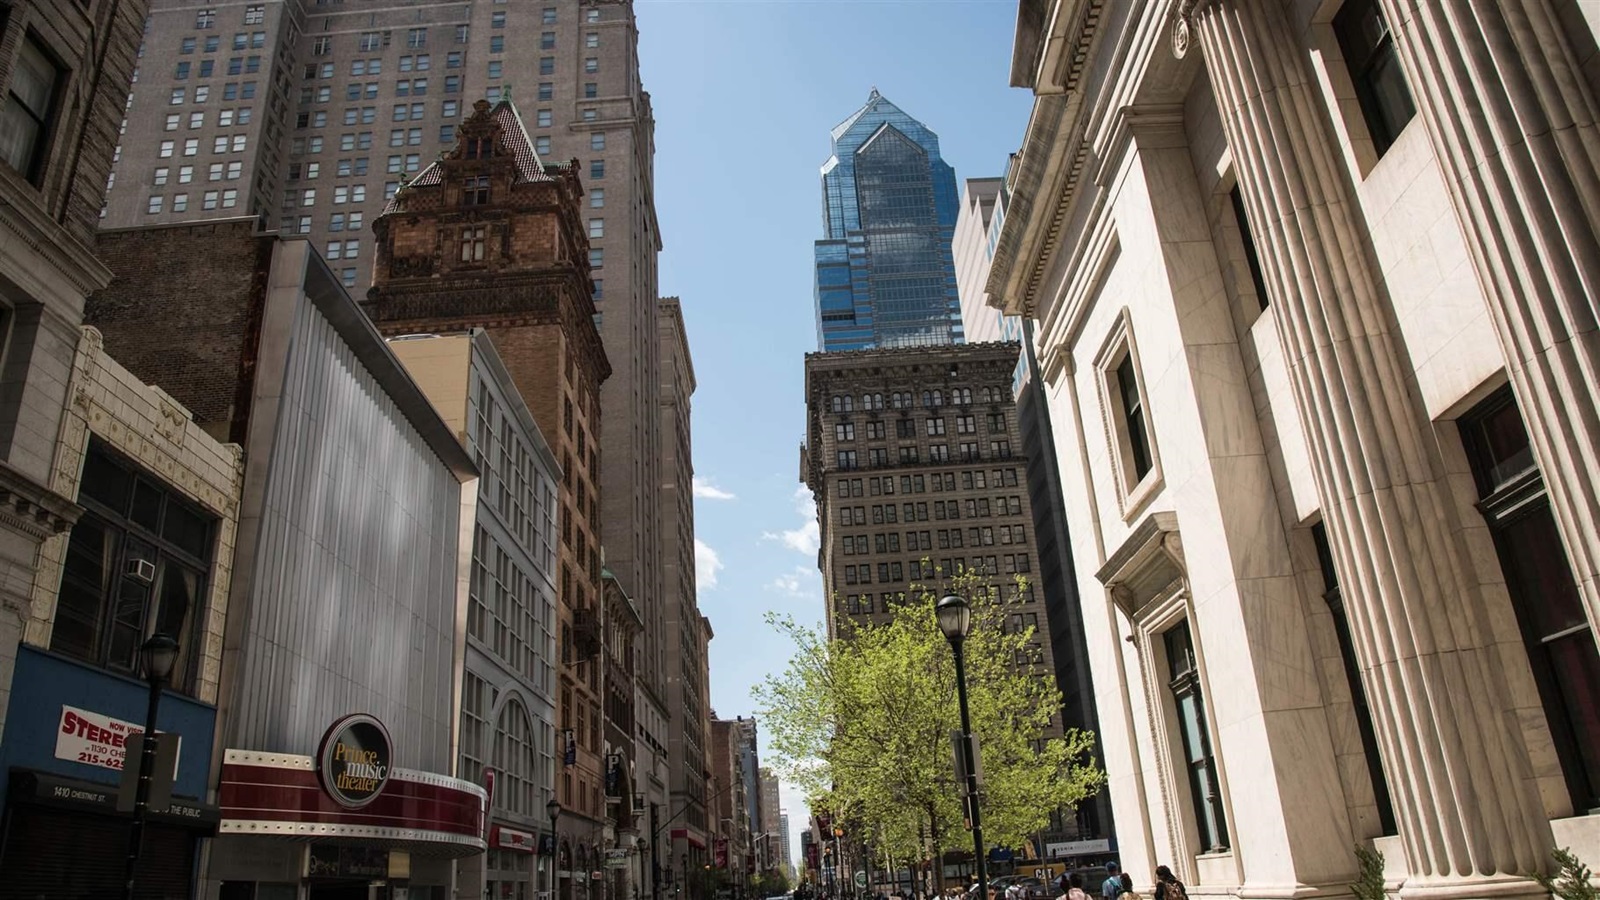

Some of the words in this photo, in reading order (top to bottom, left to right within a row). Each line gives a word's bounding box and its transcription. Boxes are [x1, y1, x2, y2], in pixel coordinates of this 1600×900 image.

[109, 722, 125, 732] NOW
[91, 744, 107, 754] 1130
[335, 742, 378, 765] Prince
[345, 760, 387, 780] music
[337, 769, 379, 791] theater
[54, 786, 70, 798] 1410
[71, 790, 98, 801] CHESTNUT
[170, 804, 182, 815] THE
[182, 807, 201, 818] PUBLIC
